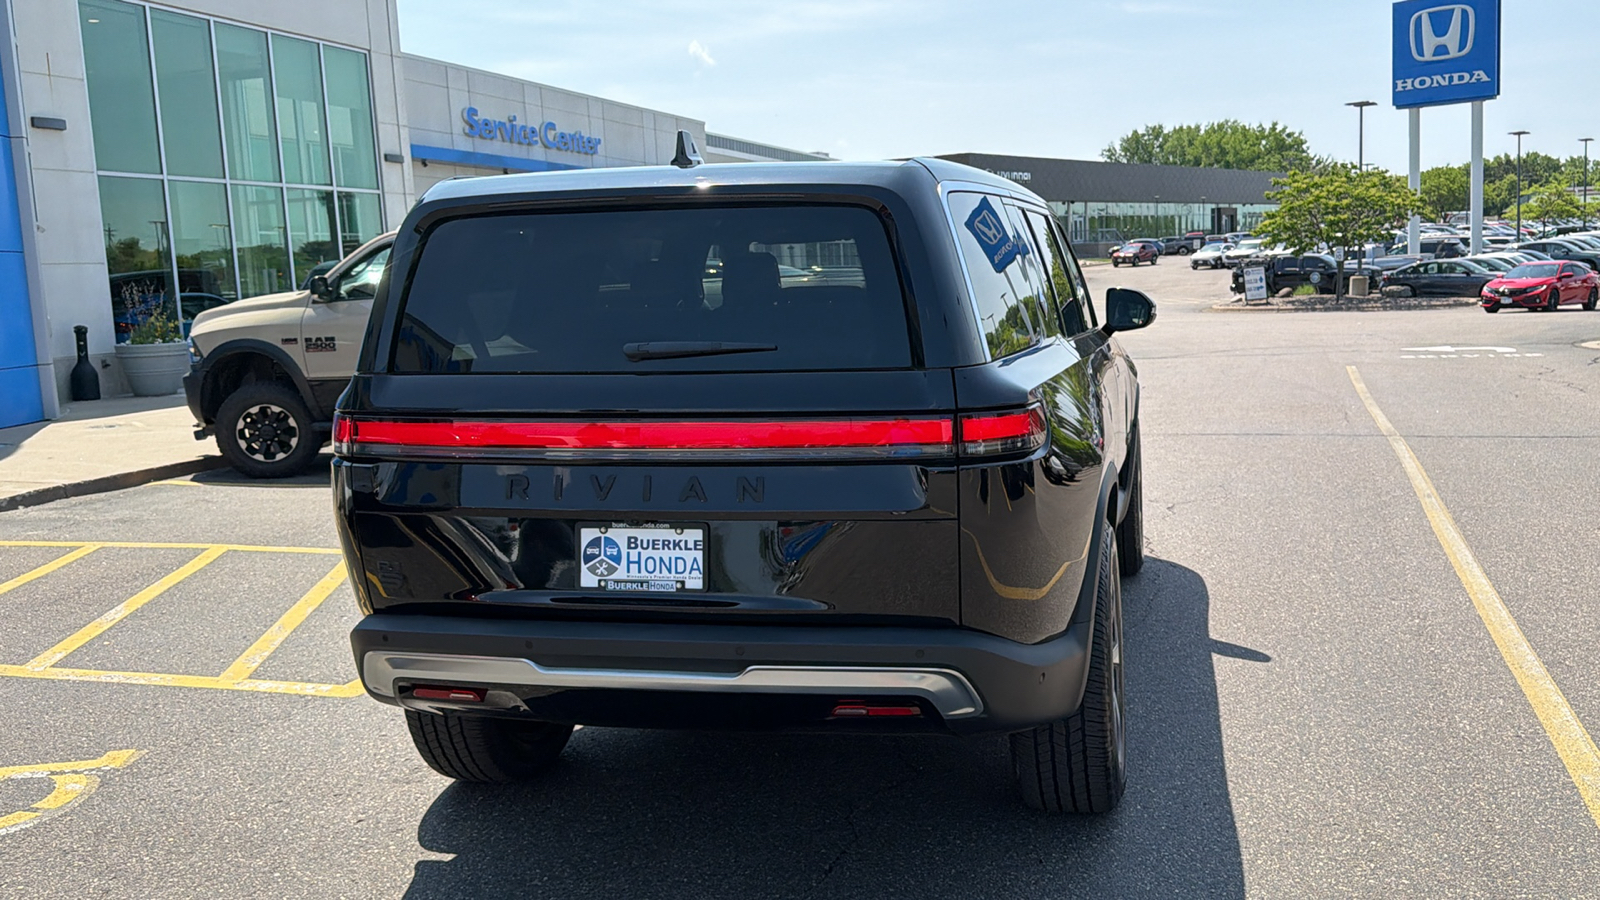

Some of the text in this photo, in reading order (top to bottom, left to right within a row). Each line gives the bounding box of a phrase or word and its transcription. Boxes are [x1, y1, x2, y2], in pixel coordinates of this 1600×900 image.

[1395, 70, 1491, 92] HONDA
[463, 106, 601, 155] Service Center
[506, 474, 765, 503] RIVIAN
[627, 536, 703, 551] BUERKLE
[626, 551, 703, 575] HONDA
